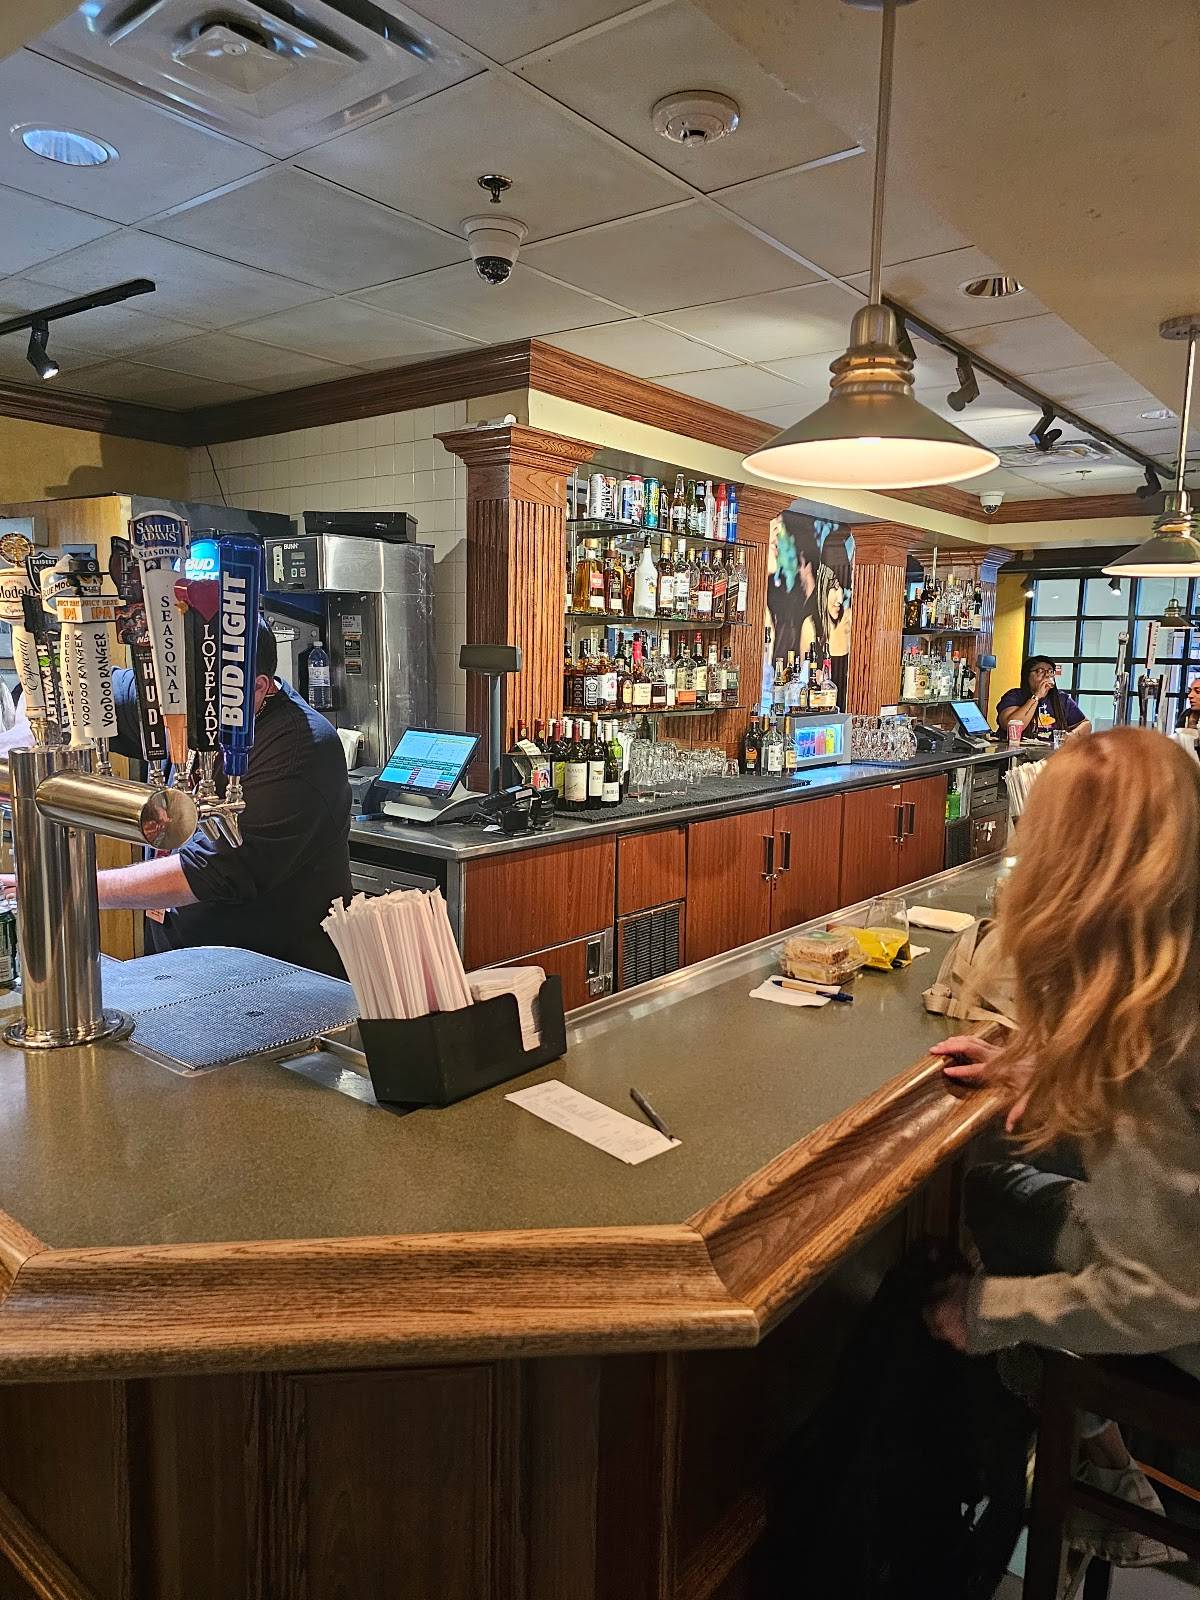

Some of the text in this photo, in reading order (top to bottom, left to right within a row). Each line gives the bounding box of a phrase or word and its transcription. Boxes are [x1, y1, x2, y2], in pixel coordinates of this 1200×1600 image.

[136, 522, 180, 534] SAMUEL
[138, 548, 180, 558] SEASONAL
[141, 533, 177, 543] ADAMS
[54, 580, 71, 591] MOO
[63, 607, 77, 620] IPA
[91, 606, 112, 619] IPA
[64, 634, 78, 727] BELGIAN WHITE
[74, 633, 91, 727] VOODOO RANGER
[94, 633, 114, 728] VOODOO RANGER
[160, 595, 180, 705] SEASONAL
[201, 624, 218, 746] LOVELADY
[221, 571, 246, 727] BUD LIGHT
[143, 662, 160, 748] HUDL
